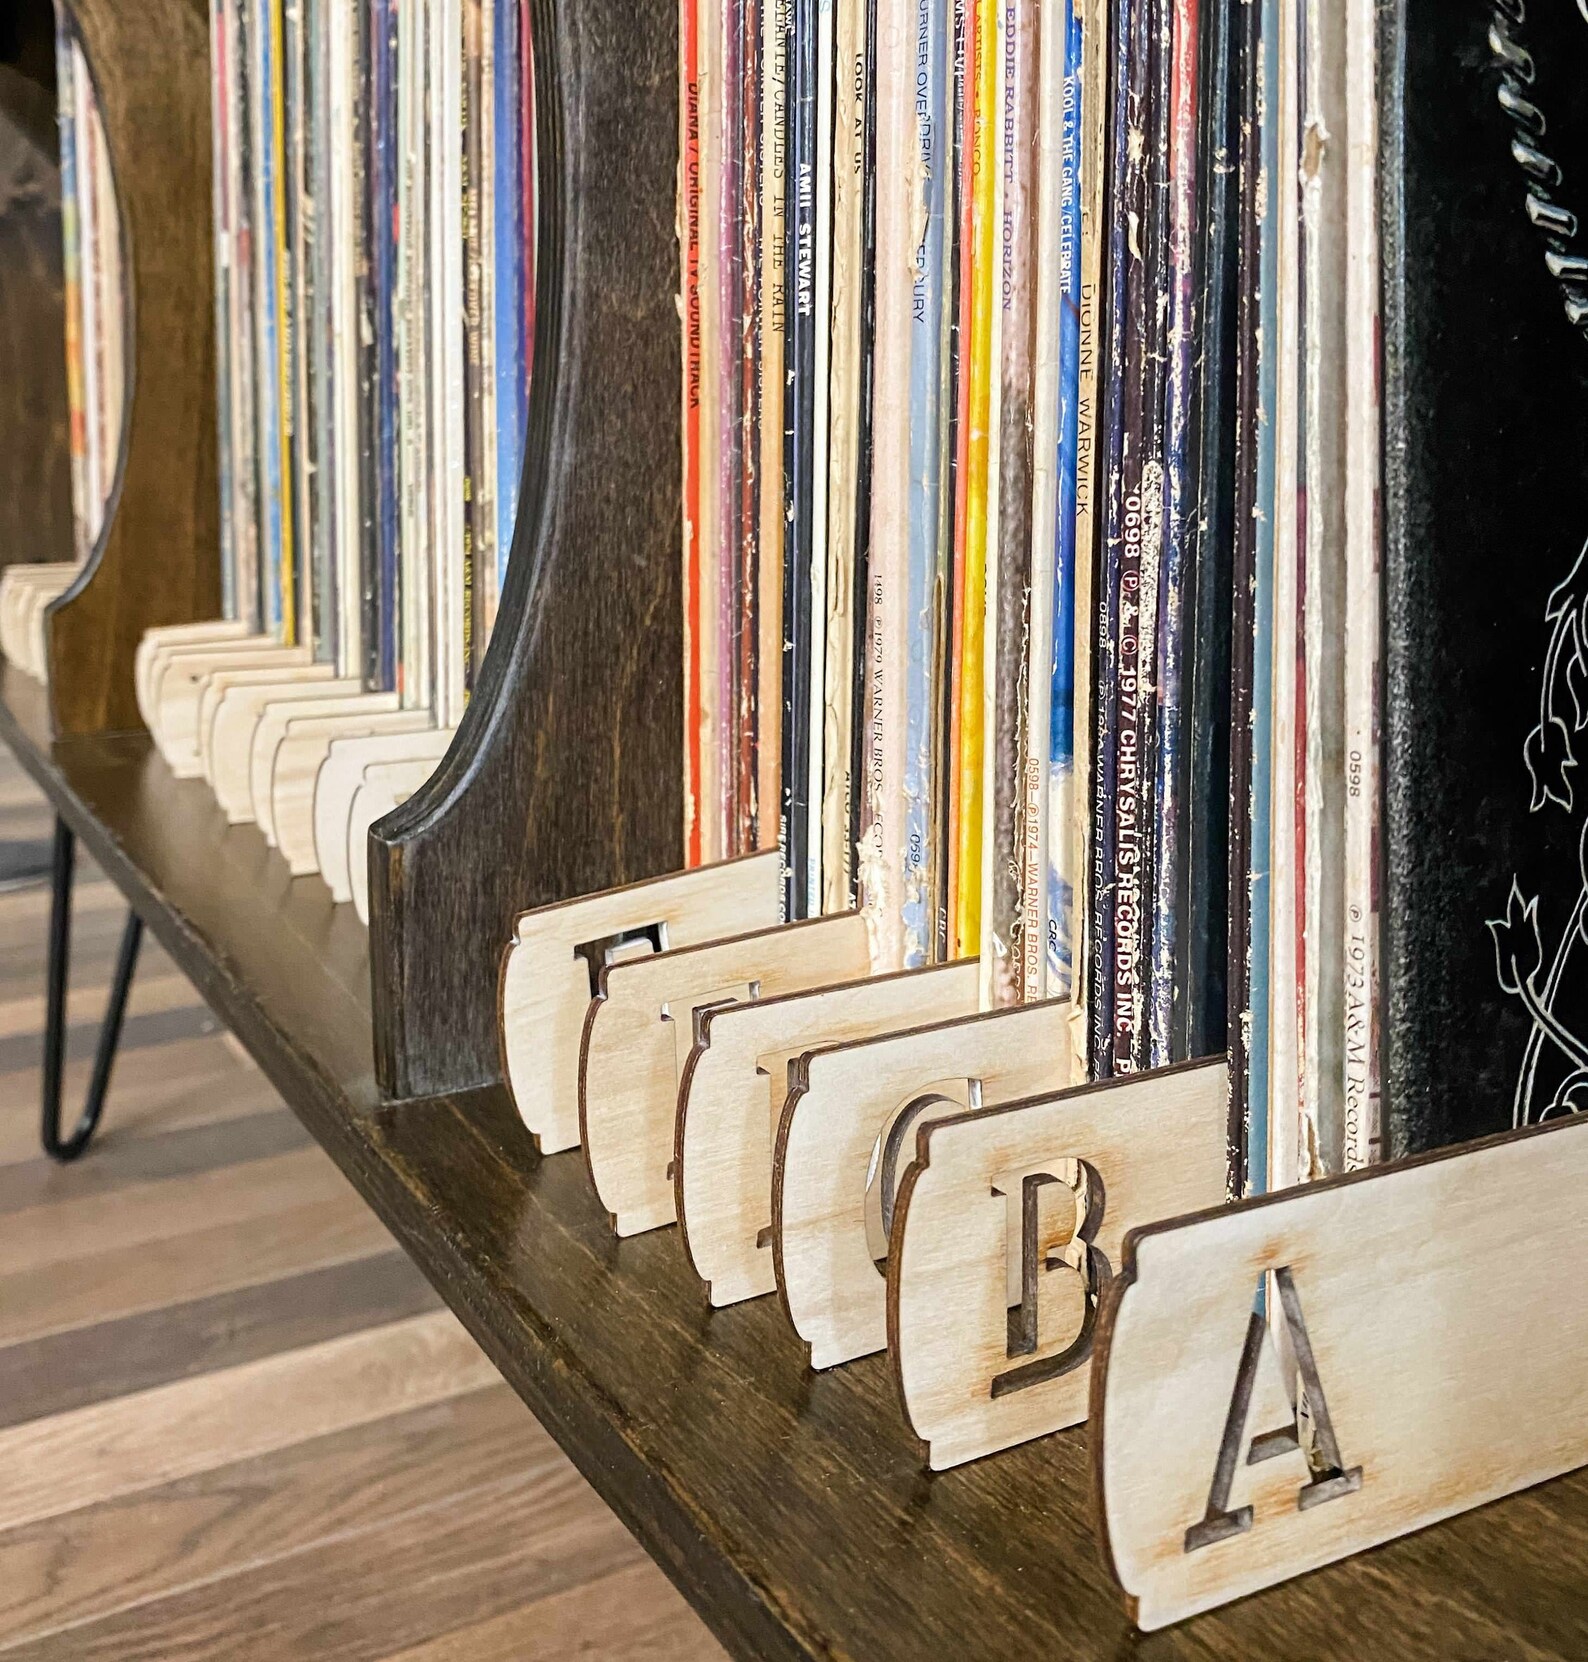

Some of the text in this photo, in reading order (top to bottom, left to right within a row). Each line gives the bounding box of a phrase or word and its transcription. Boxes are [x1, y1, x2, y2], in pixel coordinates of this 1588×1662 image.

[688, 82, 700, 140] DIANA
[1062, 76, 1075, 118] KOOL
[1062, 121, 1074, 131] &
[854, 118, 863, 138] AT
[1061, 134, 1074, 162] THE
[1002, 7, 1016, 312] EDDIE RABBITT HORIZON
[688, 162, 700, 251] ORIGINAL
[773, 195, 786, 217] IN
[772, 234, 785, 269] THE
[798, 163, 812, 317] AMII STEWART
[772, 284, 785, 333] RAIN
[690, 284, 701, 410] SOUNDTRACK
[1076, 284, 1096, 517] DIONNE WARWICK
[1124, 496, 1140, 558] 0698
[874, 574, 883, 605] 1498
[1098, 601, 1108, 648] 0898
[873, 668, 884, 742] WARNER
[1120, 666, 1138, 721] 1977
[1117, 729, 1137, 866] CHRYSALIS
[1348, 750, 1362, 798] 0598
[1026, 933, 1038, 979] BROS.
[1116, 872, 1134, 986] RECORDS
[1093, 911, 1104, 1009] RECORDS
[1347, 935, 1366, 989] 1973
[1116, 993, 1132, 1037] INC.
[1346, 993, 1366, 1064] A&M
[1346, 1075, 1366, 1173] Records
[990, 1156, 1113, 1400] B
[1184, 1264, 1364, 1554] A
